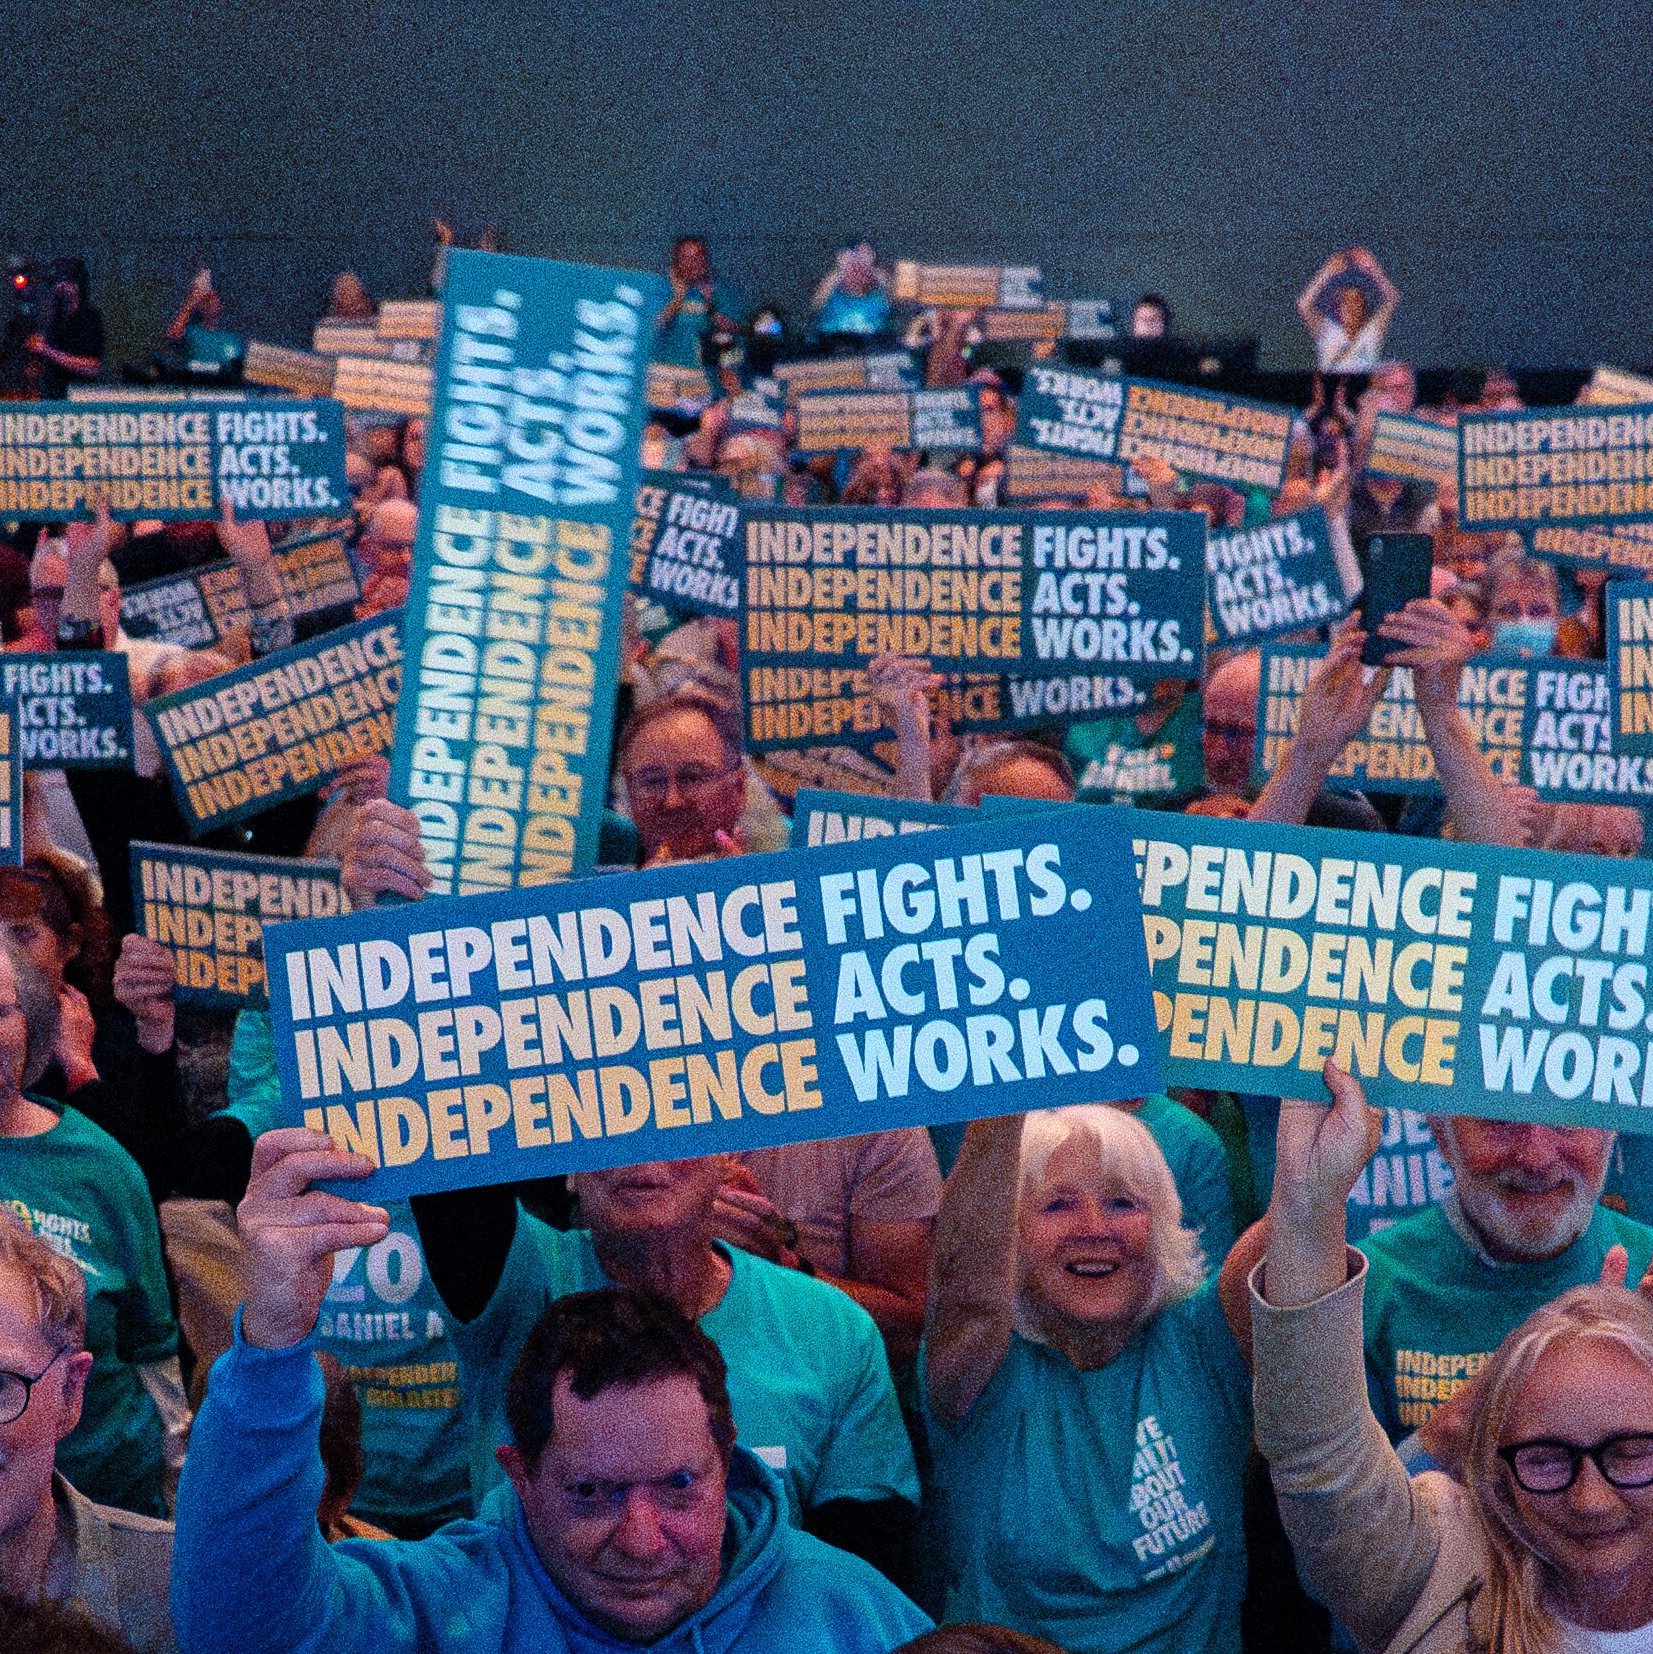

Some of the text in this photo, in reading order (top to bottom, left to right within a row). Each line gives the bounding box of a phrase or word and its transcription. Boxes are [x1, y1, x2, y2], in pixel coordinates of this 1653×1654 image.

[217, 412, 328, 443] FIGHTS.
[218, 445, 299, 475] ACTS.
[218, 477, 340, 508] WORKS.
[668, 492, 738, 539] FIGH
[658, 527, 724, 569] ACTS.
[747, 522, 1180, 569] INDEPENDENCE FIGHTS.
[1206, 520, 1315, 571] FIGHTS.
[409, 289, 522, 896] NDEPENDENCE FIGHTS.
[518, 284, 643, 887] NDEPENDENCE WORKS.
[747, 567, 1139, 614] INDEPENDENCE ACTS.
[1215, 560, 1294, 603] ACTS.
[459, 350, 575, 896] NDEPENDENCE ACTS.
[747, 611, 1193, 661] INDEPENDENCE WORKS.
[1220, 584, 1341, 636] WORKS.
[5, 665, 113, 692] FIGHTS.
[158, 623, 405, 744] INDEPENDENCE
[1009, 676, 1145, 717] WORKS.
[172, 666, 404, 781] INDEPENDENC
[187, 715, 395, 819] INDEPENDEN
[1132, 839, 1478, 938] PENDENCE
[285, 880, 806, 1022] INDEPENDENCE
[819, 843, 1092, 947] FIGHTS.
[1142, 913, 1468, 1012] PENDENCE
[294, 932, 1029, 1101] INDEPENDENCE ACTS.
[1153, 990, 1460, 1086] ENDENCE
[303, 998, 1136, 1181] INDEPENDENCE WORKS.
